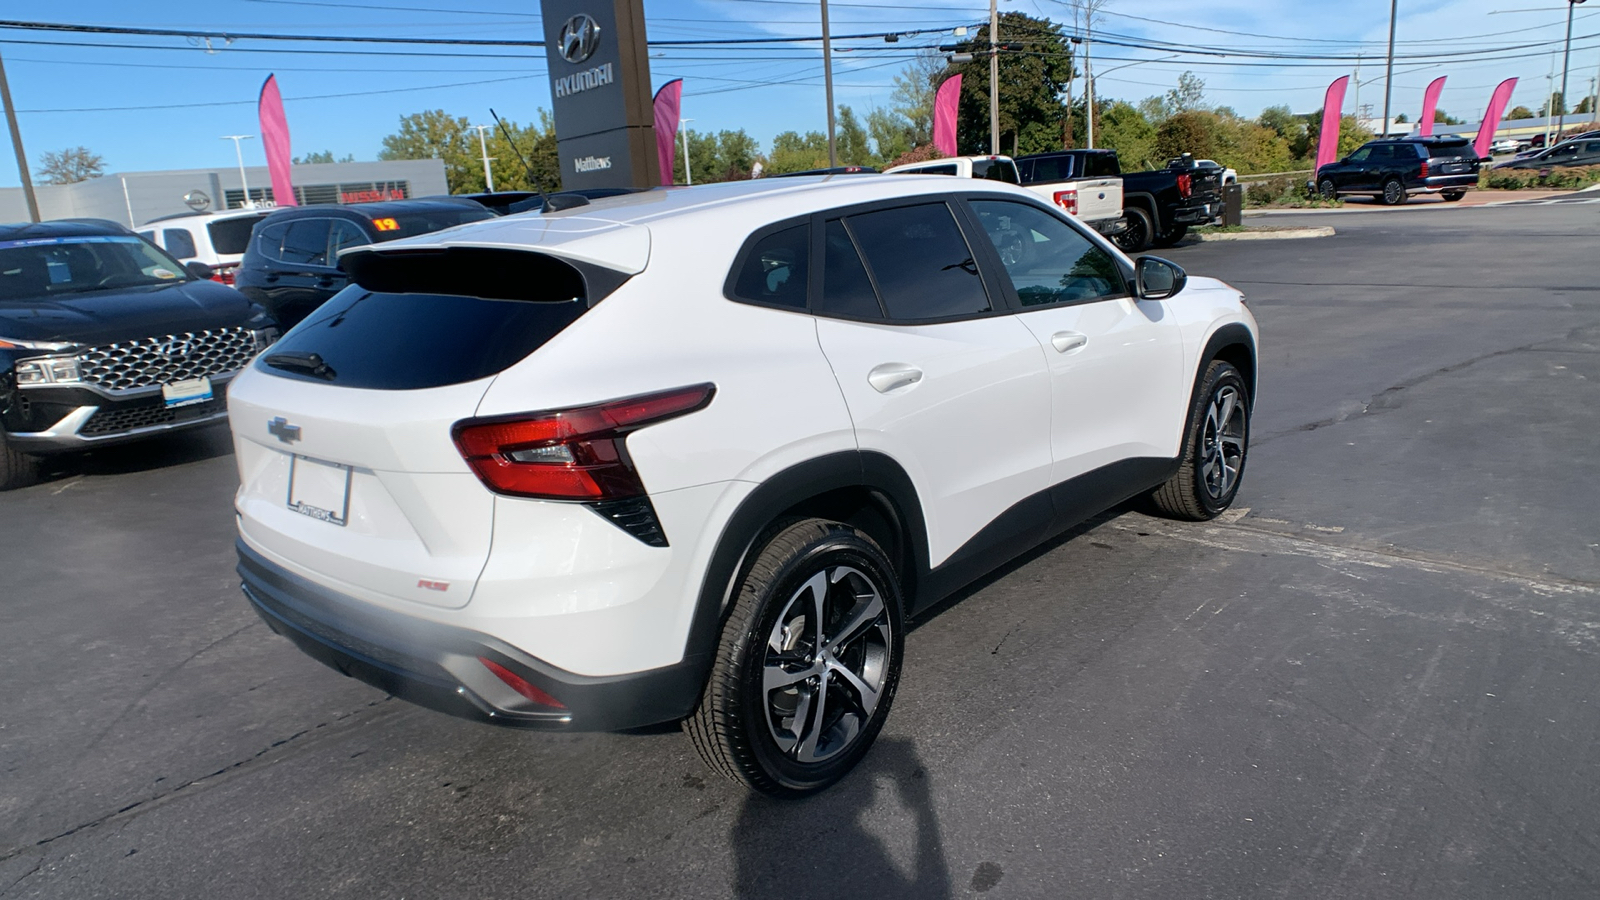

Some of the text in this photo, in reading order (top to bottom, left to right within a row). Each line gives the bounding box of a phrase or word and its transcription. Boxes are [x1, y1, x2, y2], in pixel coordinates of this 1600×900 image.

[555, 62, 613, 98] HYUNDAI
[574, 156, 612, 173] Matthews
[375, 218, 397, 231] 19
[298, 504, 331, 522] MATTHEWS
[417, 578, 450, 591] RS
